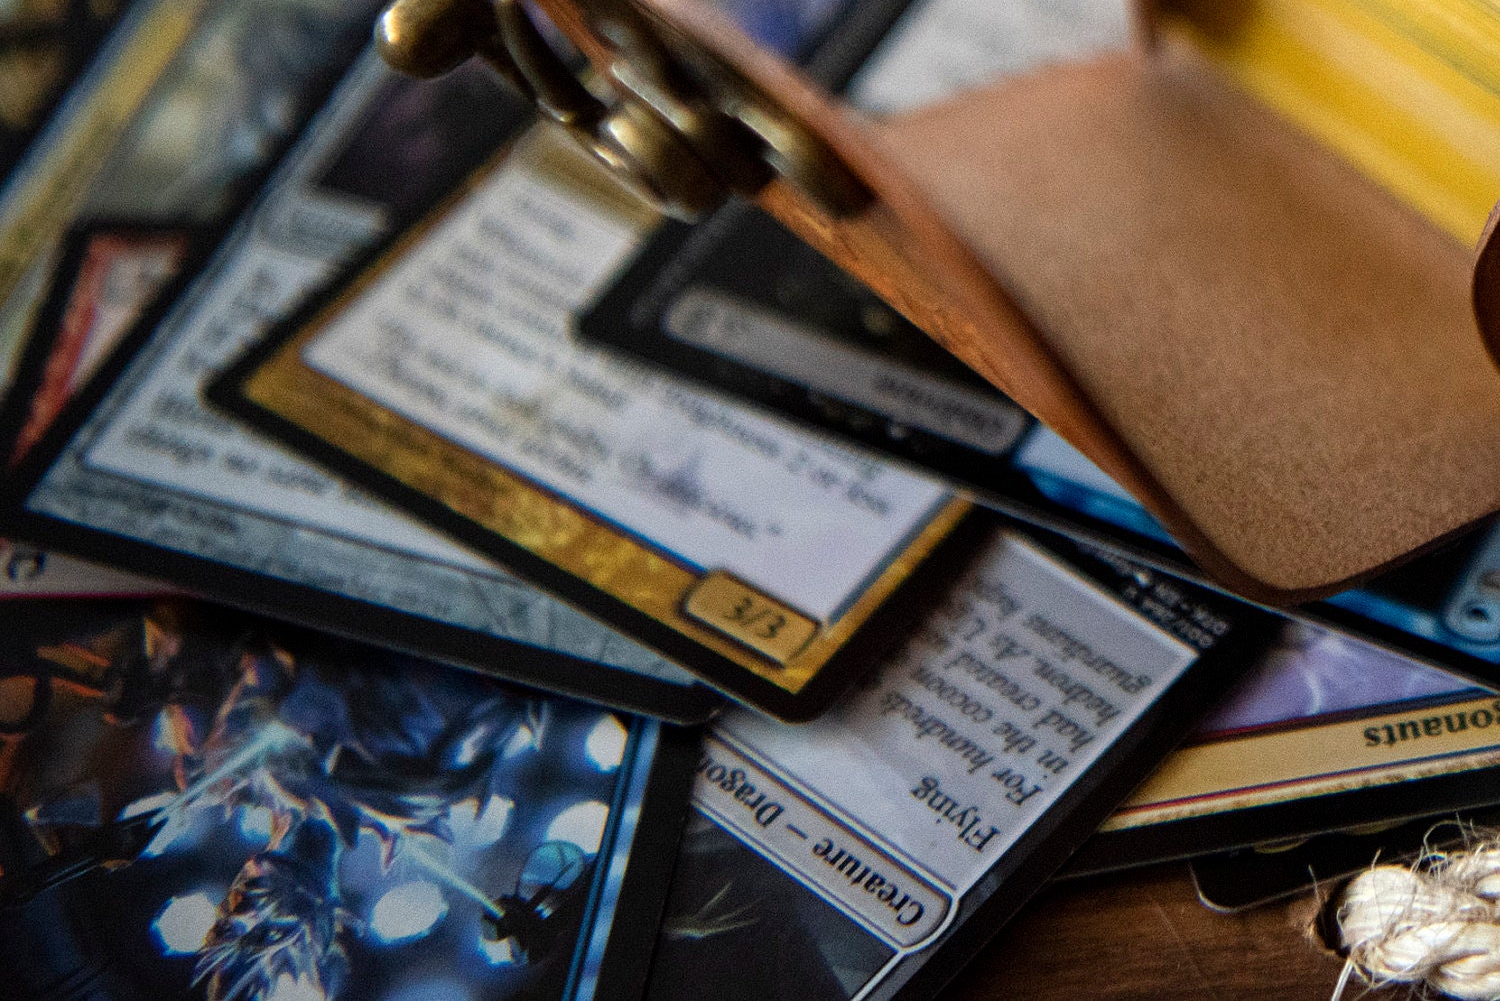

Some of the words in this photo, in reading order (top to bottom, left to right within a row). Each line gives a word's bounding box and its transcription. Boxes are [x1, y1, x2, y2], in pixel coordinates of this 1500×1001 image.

[730, 597, 787, 640] 3/3
[944, 651, 1042, 712] created
[1022, 613, 1152, 695] guardians
[911, 665, 994, 724] cocoon
[881, 691, 994, 776] hundreds
[992, 720, 1037, 756] the
[1032, 708, 1097, 755] had
[990, 764, 1042, 807] For
[1036, 749, 1070, 781] in
[910, 775, 1001, 854] Flying
[812, 837, 926, 927] Creature
